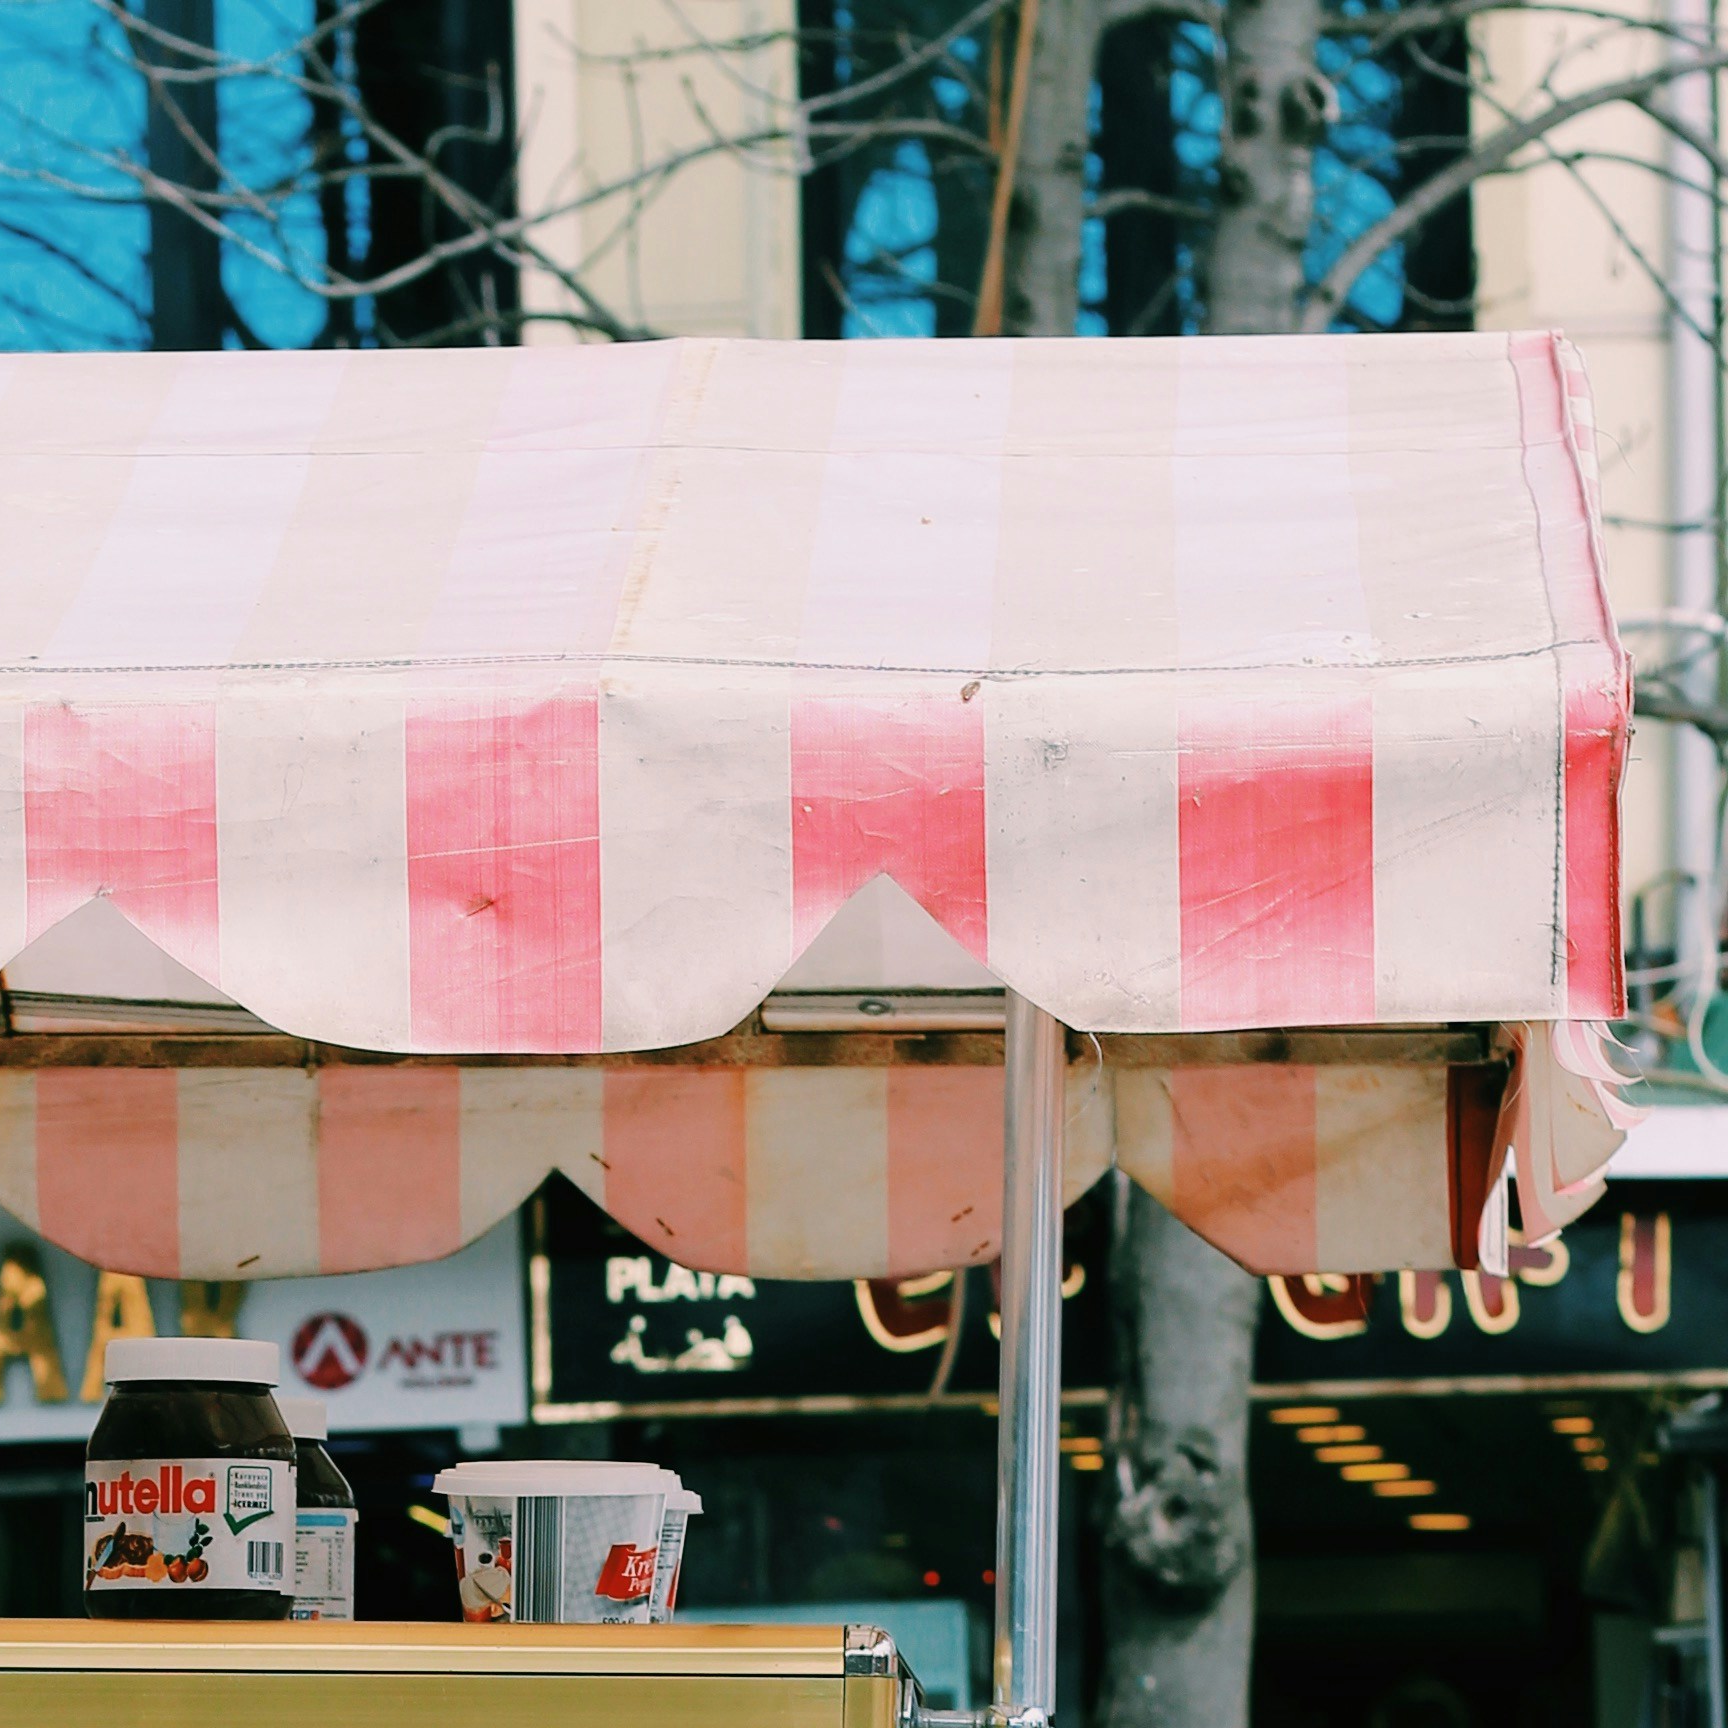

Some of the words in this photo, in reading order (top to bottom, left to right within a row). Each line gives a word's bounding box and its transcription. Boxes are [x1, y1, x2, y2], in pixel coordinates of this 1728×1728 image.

[378, 1329, 500, 1371] ANTE
[85, 1466, 215, 1514] nutella
[621, 1555, 655, 1577] Kre
